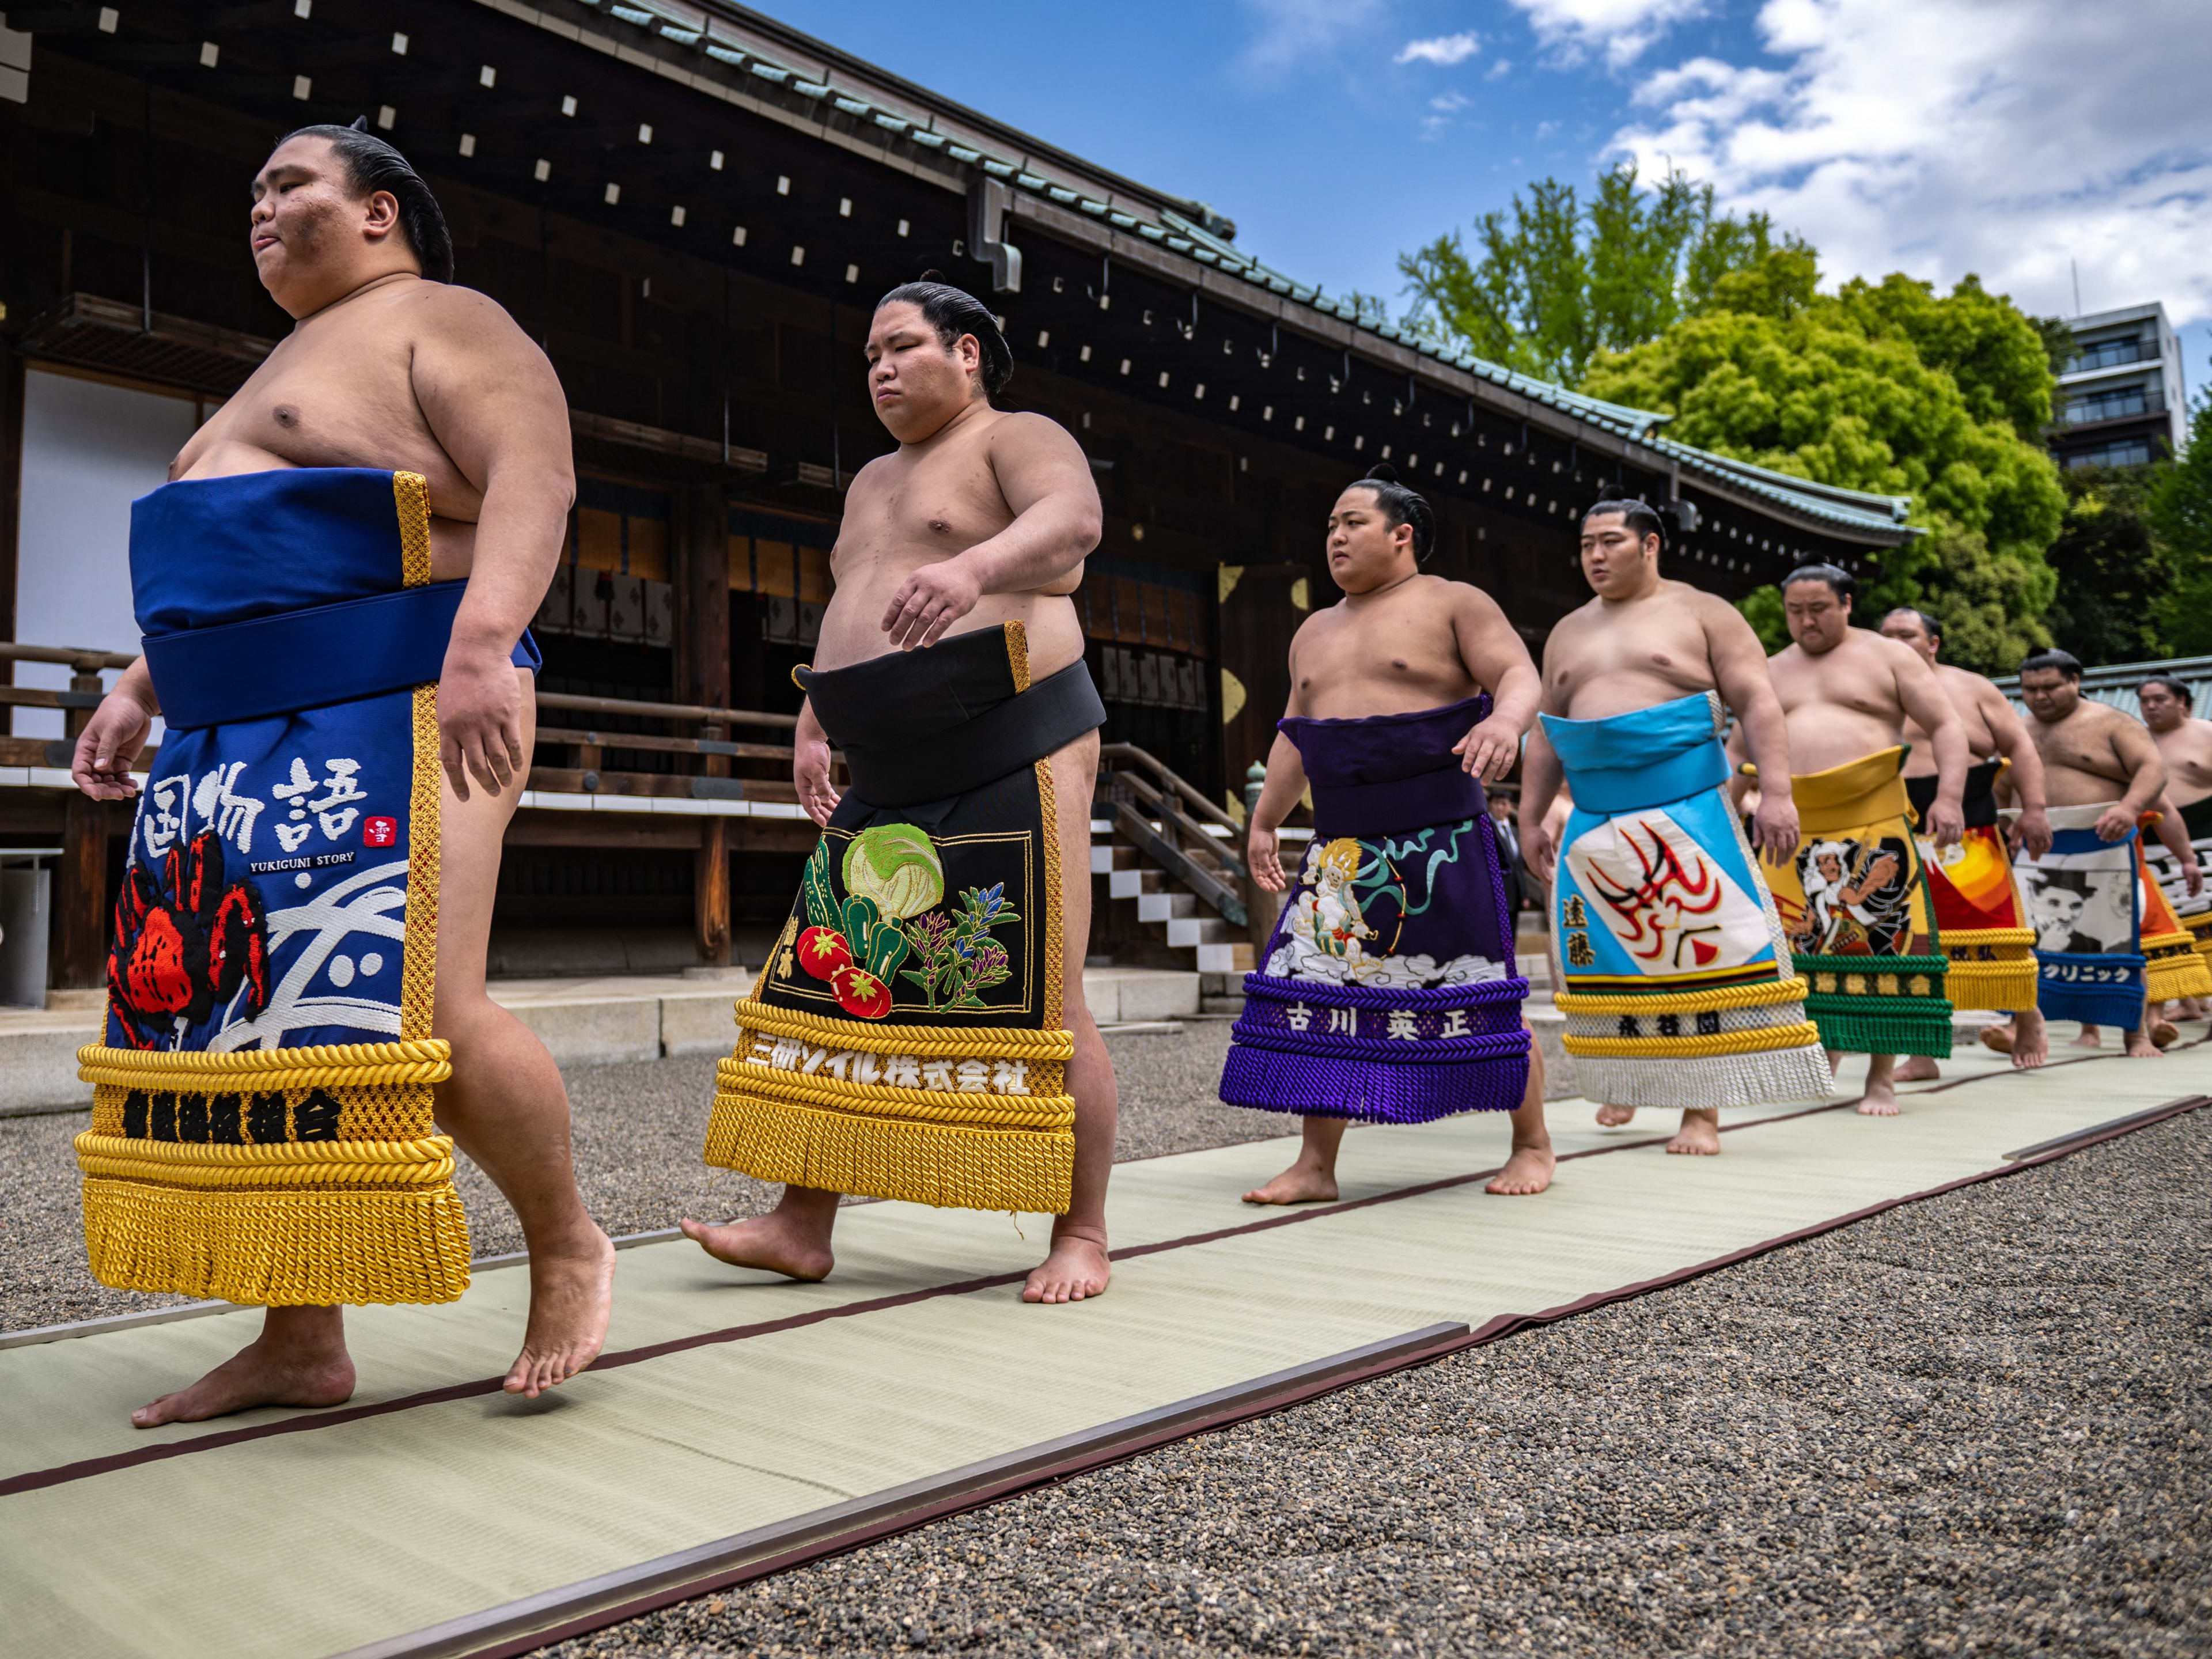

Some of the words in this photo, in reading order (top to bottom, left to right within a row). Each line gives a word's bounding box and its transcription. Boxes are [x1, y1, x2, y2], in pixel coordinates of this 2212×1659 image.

[126, 757, 368, 869] 国物語
[250, 857, 311, 872] YUKIGUNI
[317, 852, 354, 865] STORY
[1562, 893, 1596, 967] 遠藤
[2043, 963, 2131, 983] クリニック
[746, 1031, 1031, 1095] 三研ソイル株式会社
